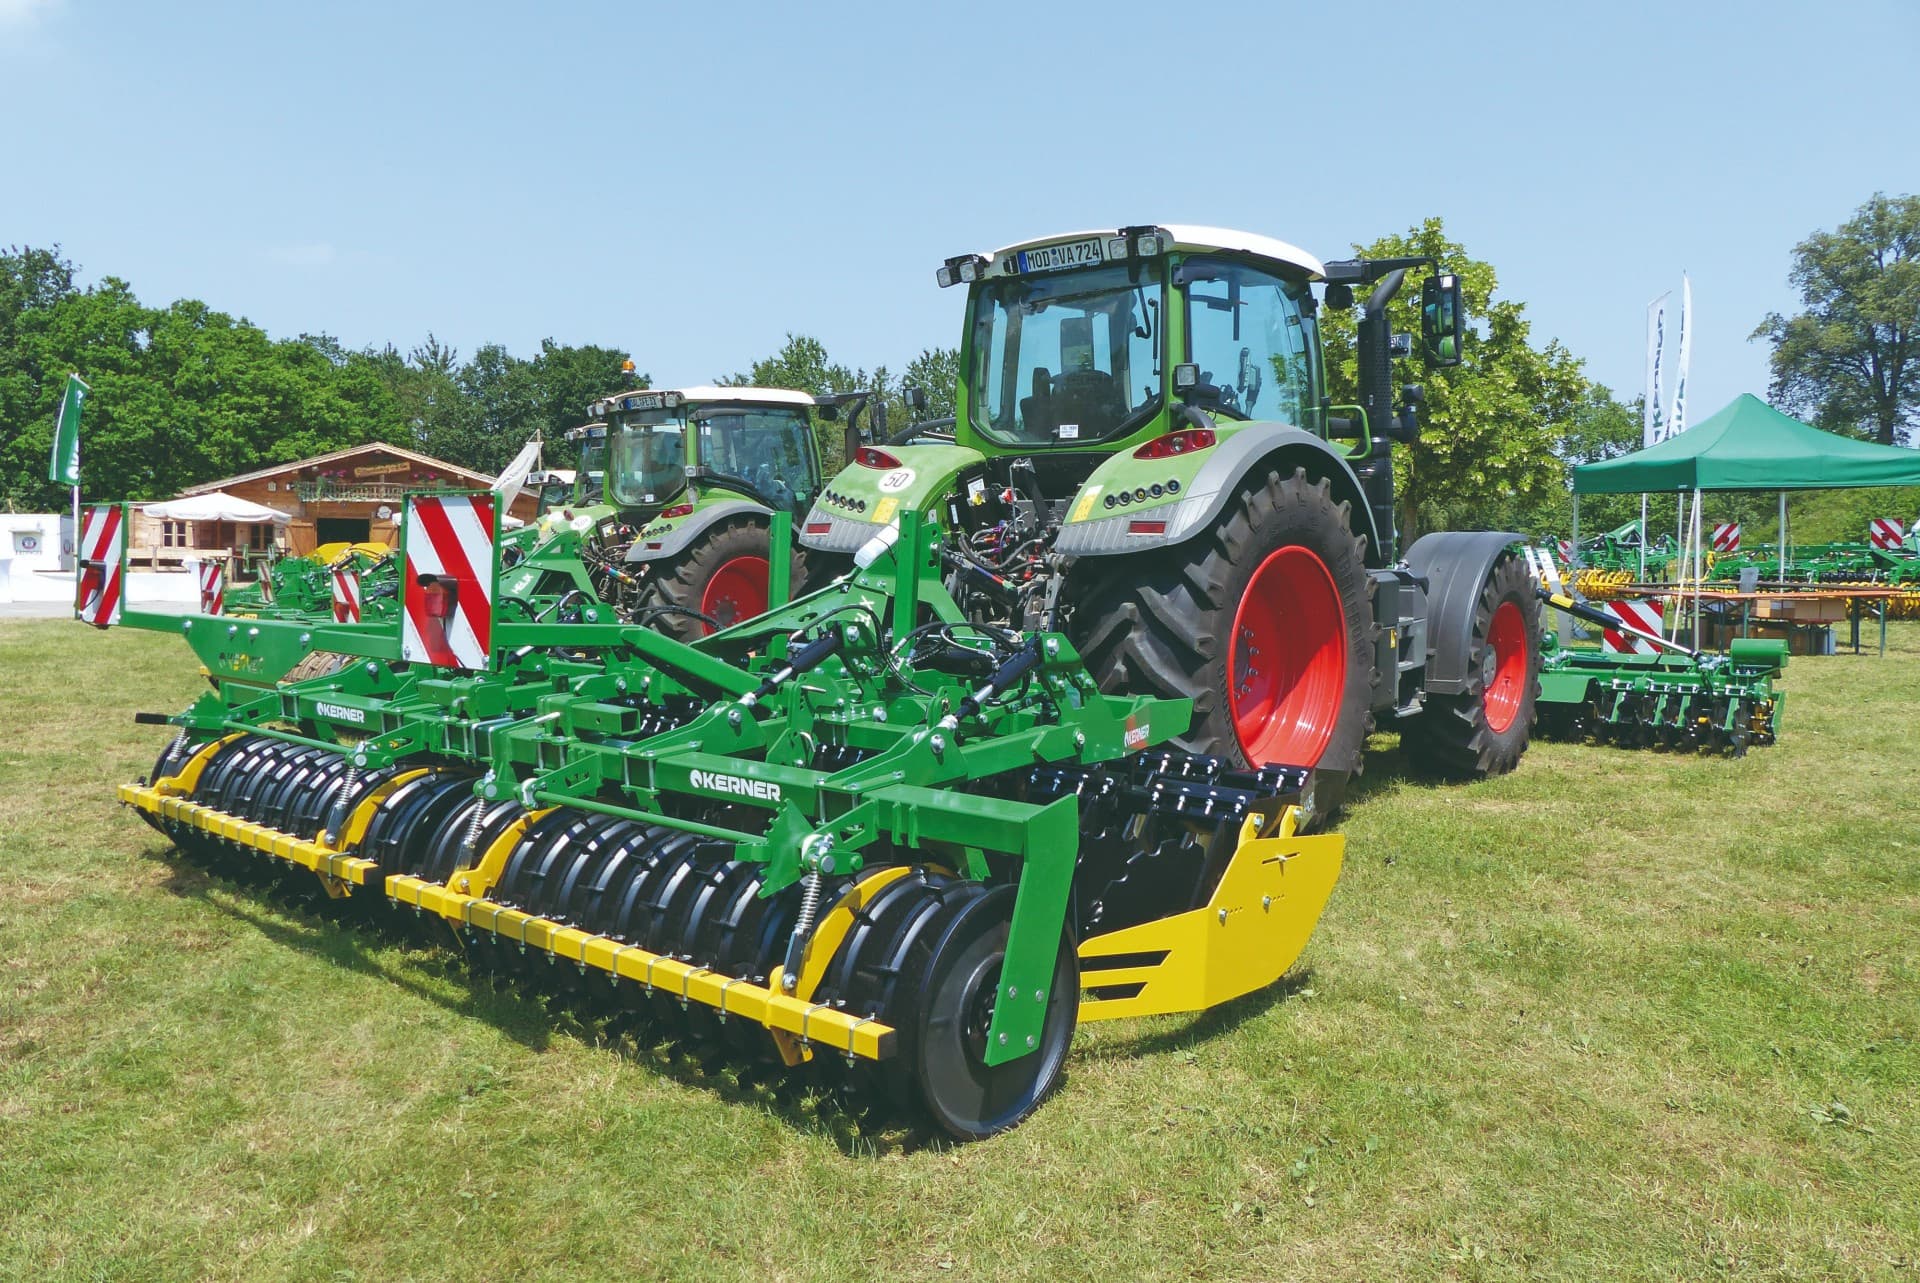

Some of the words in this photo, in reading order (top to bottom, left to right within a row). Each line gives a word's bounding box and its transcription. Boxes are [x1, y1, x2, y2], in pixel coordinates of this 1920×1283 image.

[1027, 251, 1050, 270] MOD
[1058, 246, 1074, 264] VA
[1076, 242, 1099, 261] 724
[884, 472, 909, 488] 50
[323, 703, 365, 723] KERNER
[702, 771, 781, 802] KERNER
